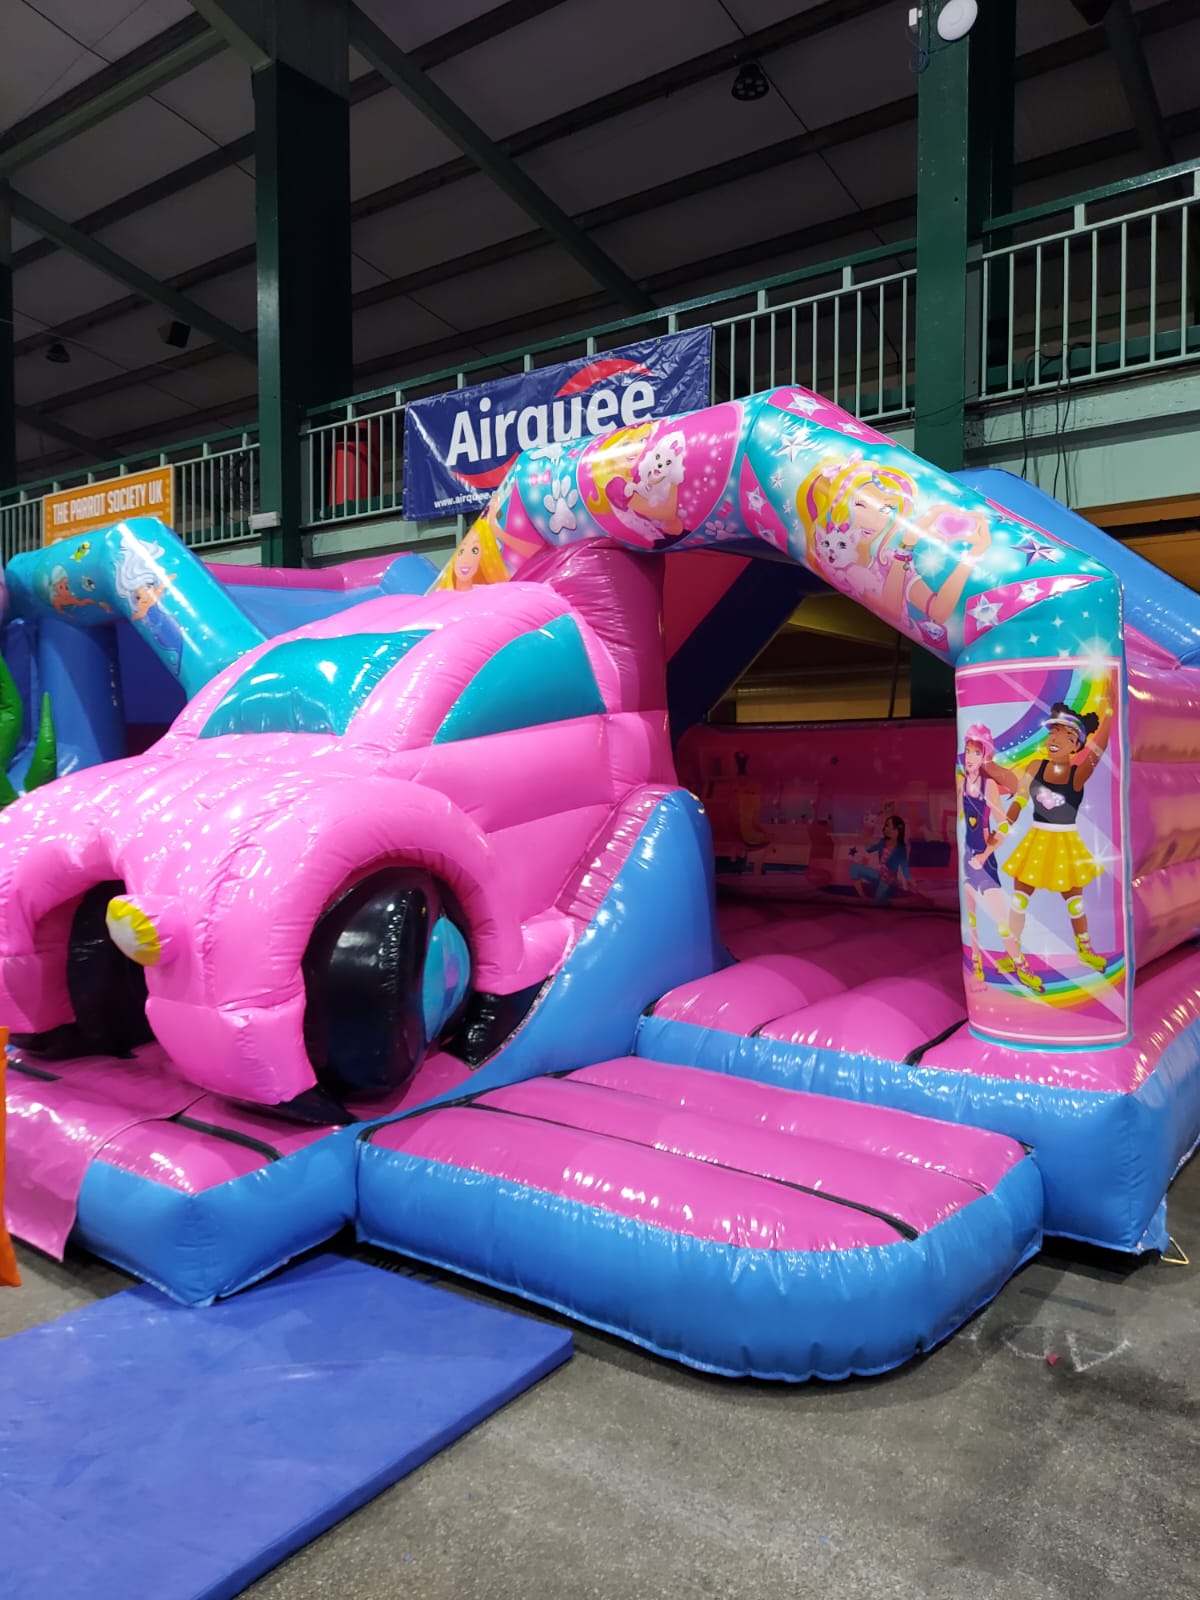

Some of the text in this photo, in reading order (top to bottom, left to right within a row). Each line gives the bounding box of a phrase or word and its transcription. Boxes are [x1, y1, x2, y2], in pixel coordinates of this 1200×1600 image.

[446, 380, 656, 467] Airquee
[52, 479, 163, 526] THE PARROT SOCIETY UK
